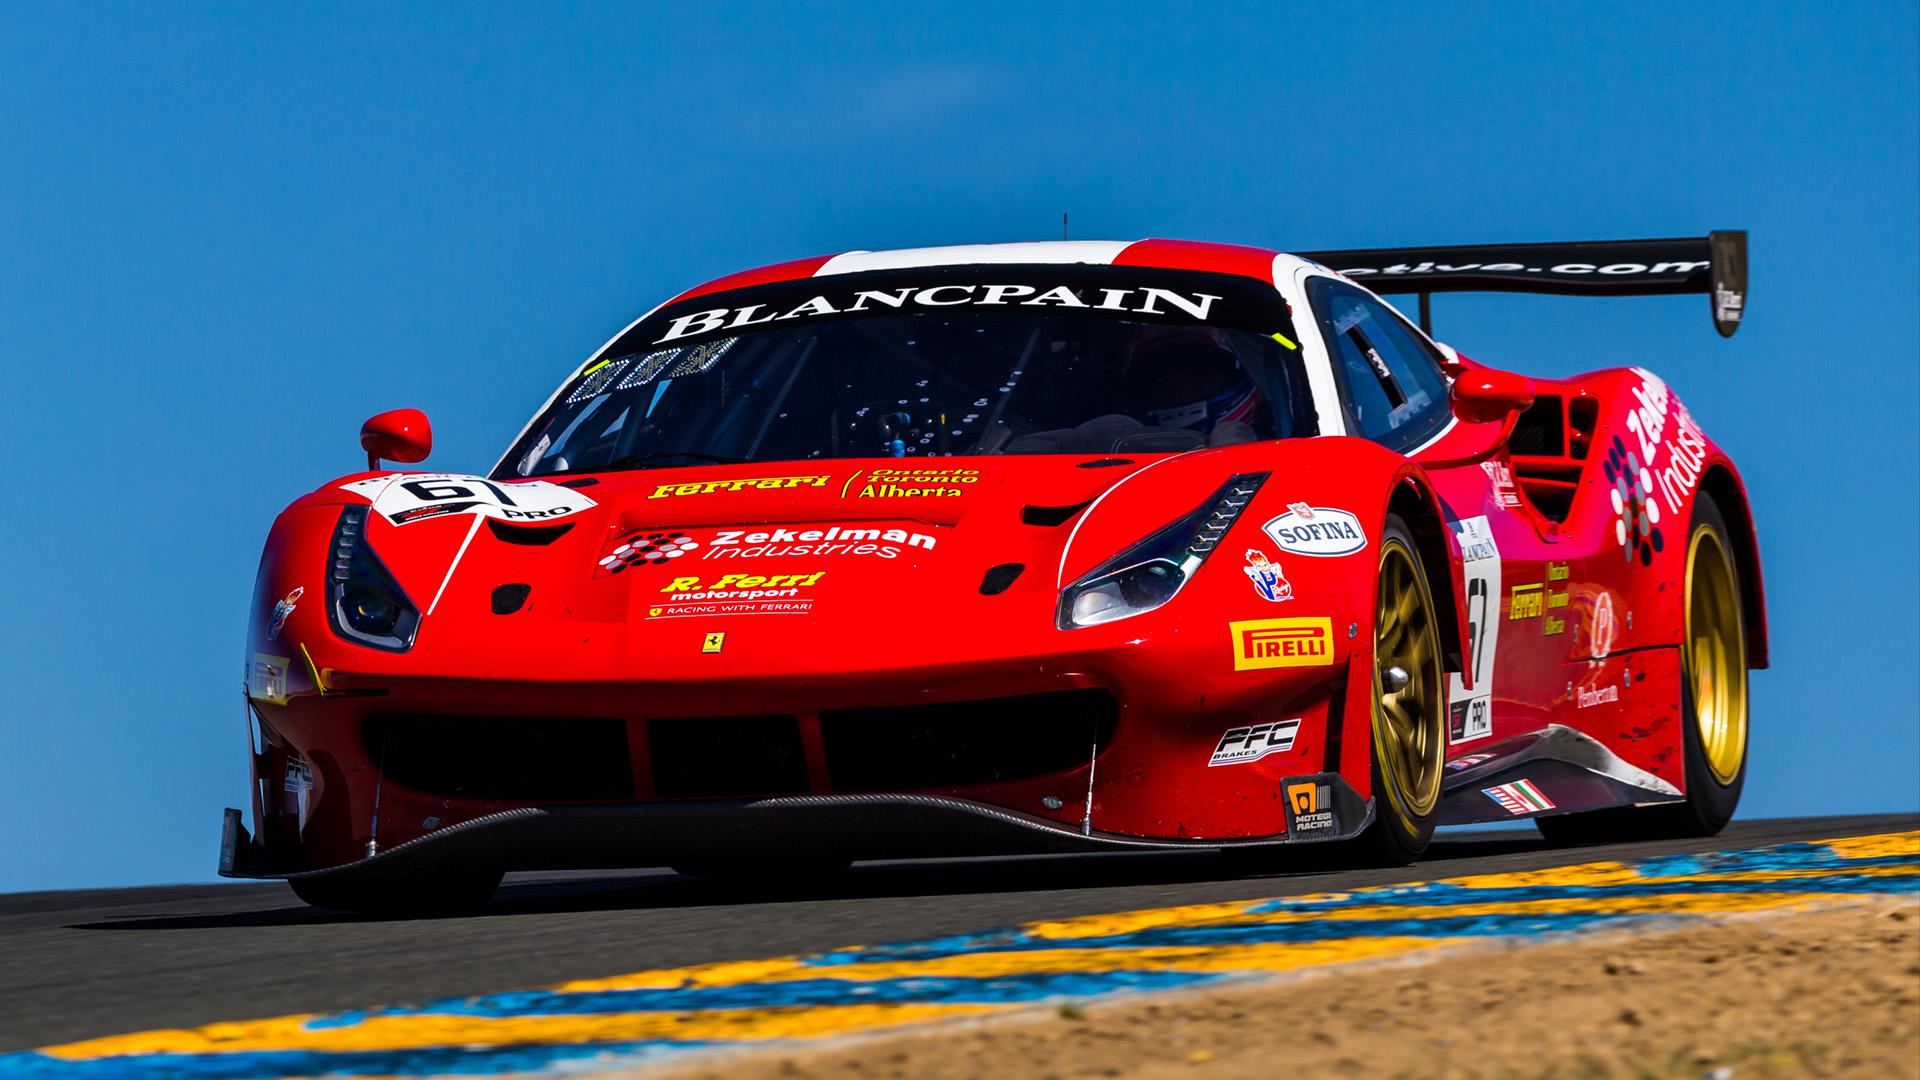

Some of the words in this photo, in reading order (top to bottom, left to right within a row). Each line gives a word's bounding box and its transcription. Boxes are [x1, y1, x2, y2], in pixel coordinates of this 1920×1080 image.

[651, 284, 1223, 346] BLANCPAIN
[866, 474, 980, 484] Toronto
[870, 468, 981, 476] Ontario
[400, 479, 518, 507] 61
[646, 475, 832, 500] Ferrari
[857, 484, 964, 498] Alberta
[501, 506, 573, 520] PRO
[708, 526, 937, 551] Zekelman
[1278, 521, 1359, 544] SOFINA
[702, 541, 902, 560] Industries
[659, 576, 703, 593] R.
[708, 571, 827, 590] Ferri
[670, 587, 799, 602] motorsport
[667, 605, 716, 614] RACING
[721, 604, 756, 613] WITH
[760, 603, 813, 612] FERRARI
[1242, 626, 1326, 659] PIRELLI
[1216, 720, 1299, 753] PFC
[1213, 749, 1258, 760] BRAKES
[1295, 812, 1332, 823] MOTEGI
[1296, 820, 1333, 831] RACING
